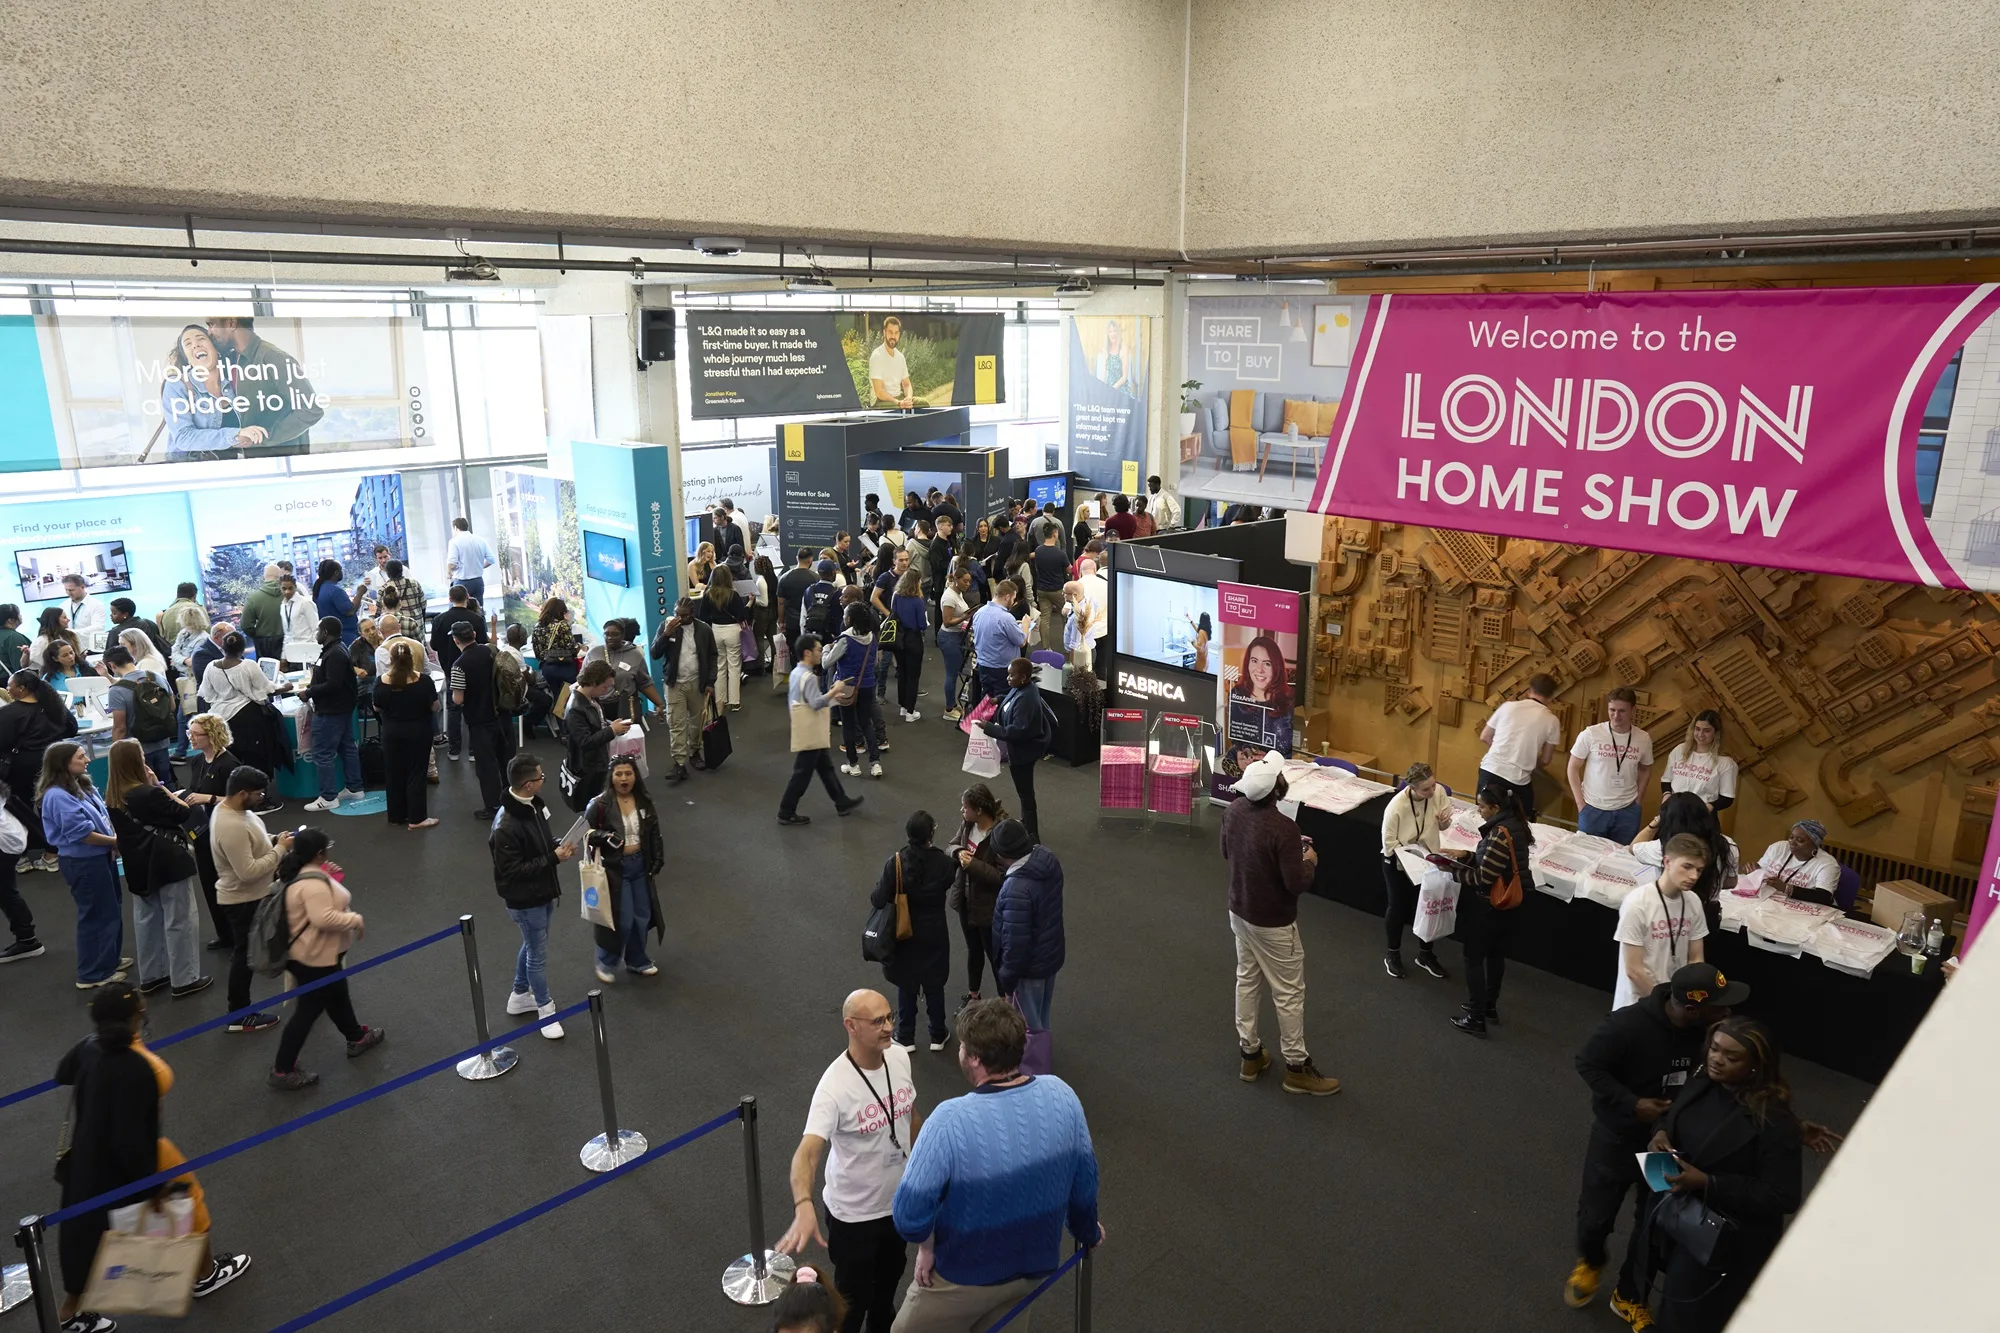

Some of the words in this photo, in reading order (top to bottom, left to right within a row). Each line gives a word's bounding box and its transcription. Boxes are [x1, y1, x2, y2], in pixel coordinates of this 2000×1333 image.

[724, 326, 748, 336] made
[750, 326, 756, 336] it
[757, 328, 767, 336] so
[769, 327, 788, 338] easy
[789, 327, 799, 336] as
[800, 328, 806, 336] a
[1208, 325, 1252, 338] SHARE
[1468, 315, 1618, 351] Welcome
[1631, 323, 1665, 352] to
[1679, 315, 1737, 352] the
[702, 340, 742, 350] first-time
[744, 339, 770, 351] buyer.
[772, 340, 778, 349] It
[780, 339, 803, 349] made
[804, 339, 818, 349] the
[703, 354, 730, 364] whole
[731, 354, 763, 365] journey
[765, 353, 788, 363] much
[790, 352, 806, 362] less
[1214, 351, 1231, 363] TO
[1245, 356, 1272, 369] BUY
[136, 359, 210, 383] More
[216, 357, 279, 382] than
[285, 358, 328, 385] just
[703, 367, 740, 377] stressful
[741, 366, 761, 377] than
[762, 367, 766, 376] I
[767, 366, 783, 376] had
[978, 360, 993, 371] L&Q
[142, 398, 162, 416] a
[170, 390, 250, 423] place
[257, 390, 284, 413] to
[290, 386, 332, 410] live
[1087, 405, 1100, 413] L&Q
[1101, 406, 1115, 414] team
[1103, 415, 1115, 424] kept
[1401, 372, 1814, 465] LONDON
[1075, 422, 1100, 431] informed
[1075, 433, 1091, 441] every
[788, 450, 802, 458] L&Q
[1124, 464, 1136, 472] L&Q
[707, 476, 715, 484] in
[717, 475, 743, 483] homes
[692, 484, 764, 506] neighbourhoods
[786, 489, 807, 497] Homes
[1397, 457, 1564, 515] HOME
[1580, 472, 1799, 538] SHOW
[274, 503, 282, 511] a
[285, 500, 319, 513] place
[321, 498, 332, 507] to
[13, 523, 40, 533] Find
[43, 522, 71, 532] your
[75, 519, 107, 529] place
[110, 517, 122, 525] at
[651, 513, 664, 557] Peabody
[1227, 595, 1245, 603] SHARE
[1241, 607, 1253, 615] BUY
[1118, 671, 1185, 702] FABRICA
[1598, 743, 1640, 753] LONDON
[1673, 761, 1713, 774] LONDON
[860, 1116, 889, 1135] HOM
[893, 1102, 914, 1120] SHO
